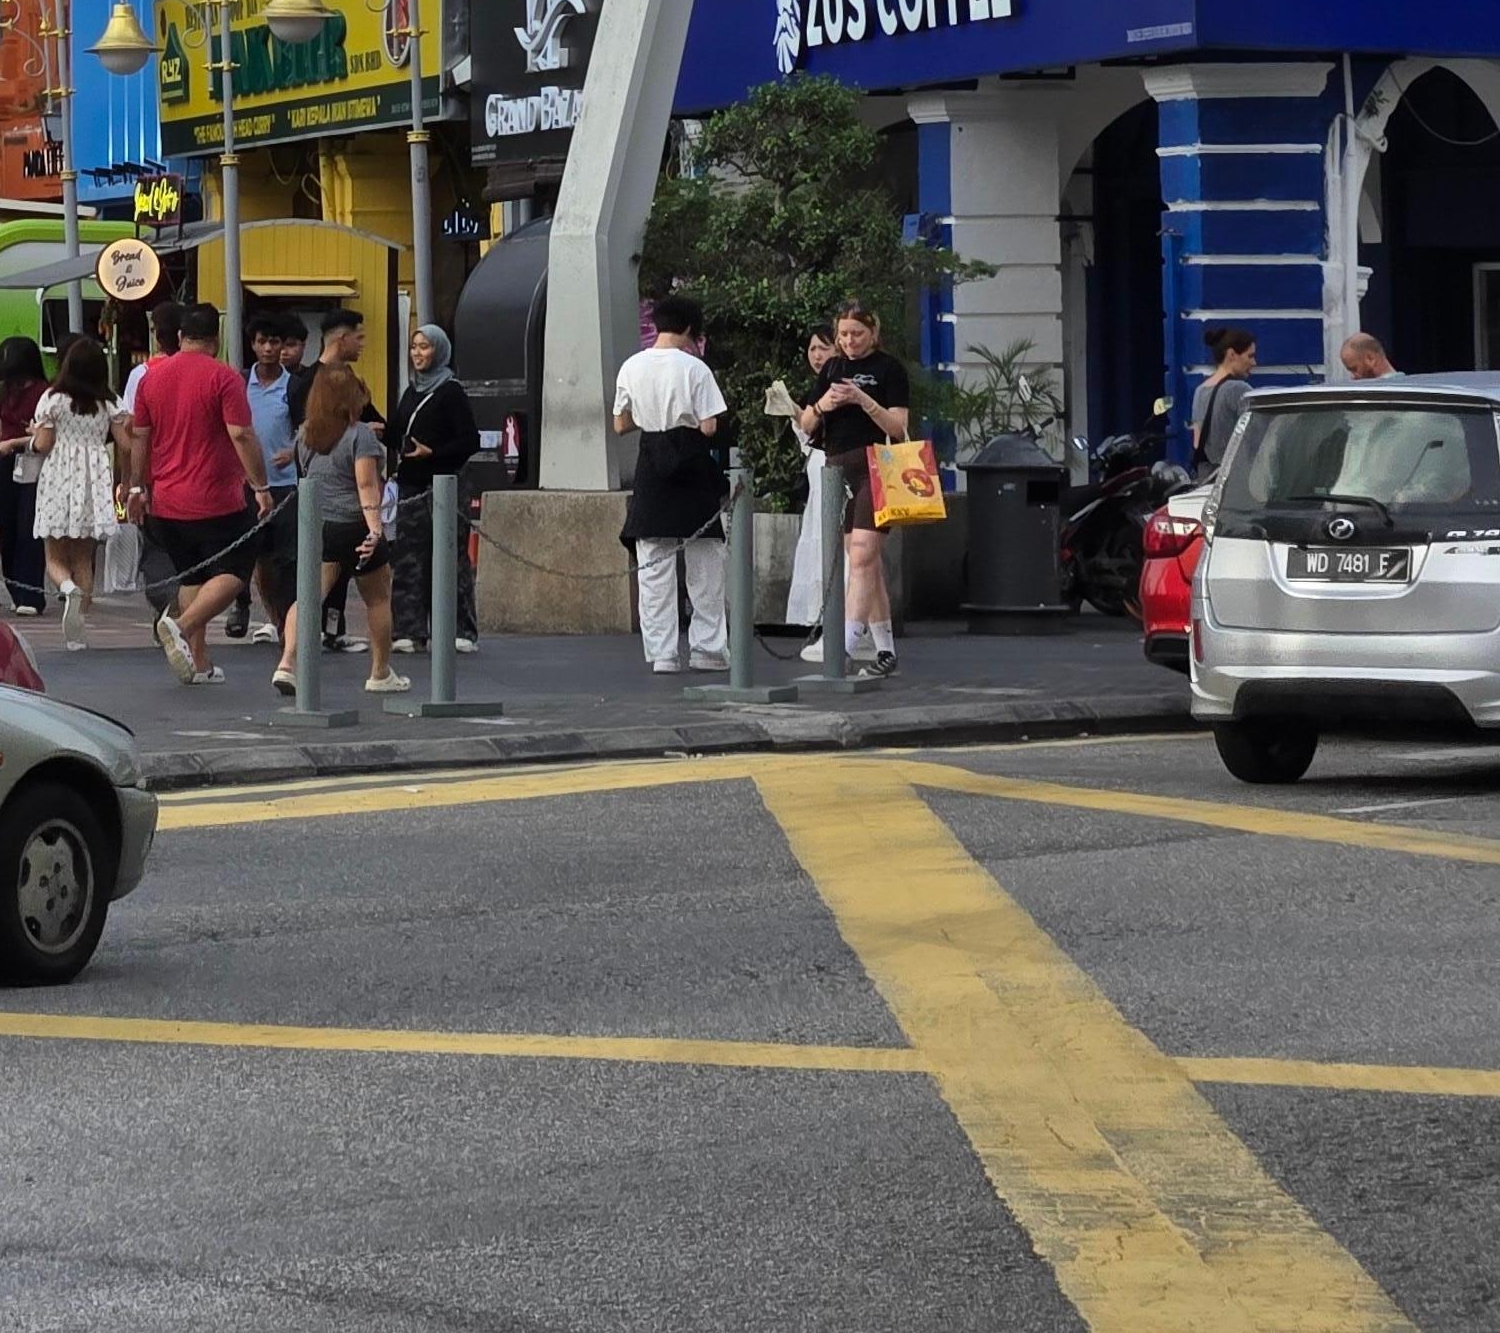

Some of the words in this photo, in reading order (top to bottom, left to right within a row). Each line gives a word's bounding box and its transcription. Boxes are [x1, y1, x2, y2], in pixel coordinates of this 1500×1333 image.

[111, 249, 143, 266] Bread
[116, 276, 145, 292] Juice
[1307, 553, 1329, 573] WD
[1336, 553, 1370, 573] 7481
